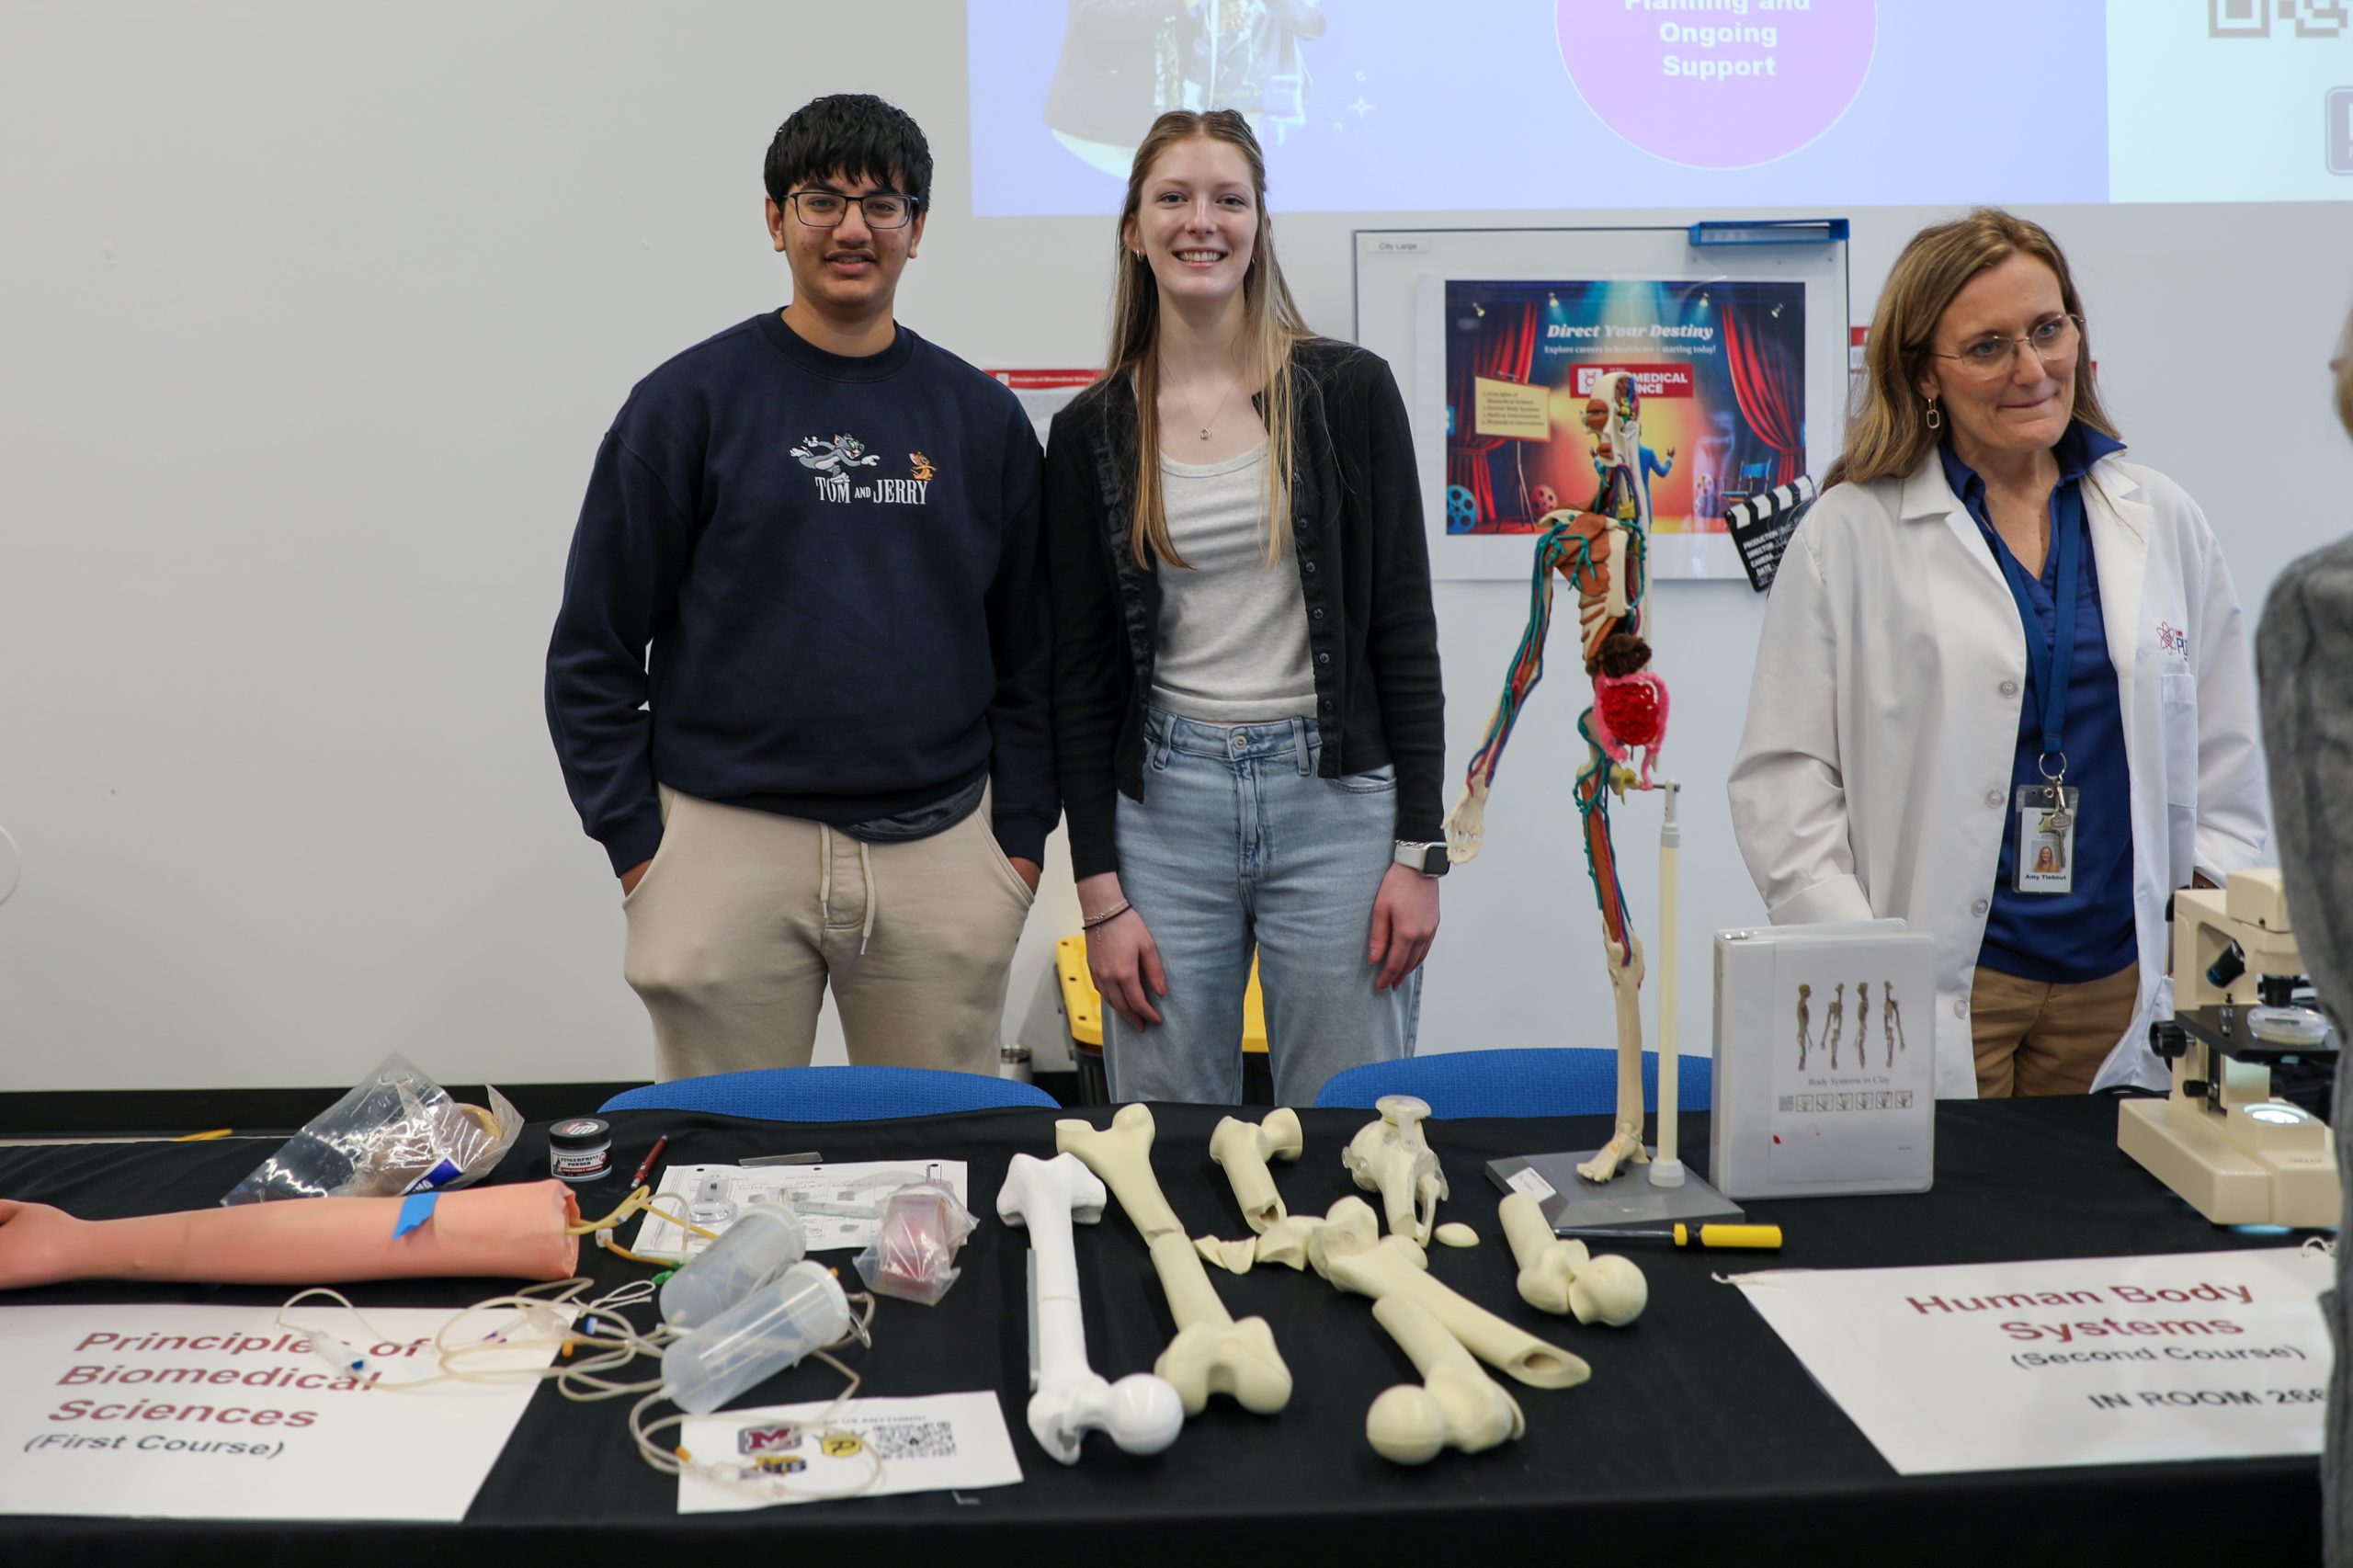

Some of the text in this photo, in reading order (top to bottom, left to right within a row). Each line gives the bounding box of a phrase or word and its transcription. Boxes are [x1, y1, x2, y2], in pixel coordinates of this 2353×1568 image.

[1659, 21, 1779, 48] Ongoing
[1662, 55, 1777, 81] Support
[1547, 324, 1714, 341] Direct Your Destiny
[1544, 345, 1716, 356] Explore careers in healthcare starting today!
[1633, 372, 1688, 383] MEDICAL
[814, 476, 928, 505] TOM AND JERRY
[1743, 530, 1779, 550] PRODUCTION
[1746, 541, 1775, 560] DIRECTOR
[1750, 552, 1775, 568] CAMERA
[1756, 564, 1773, 576] DATE
[2025, 873, 2040, 881] Amy
[1808, 1078, 1828, 1086] Body
[1830, 1077, 1861, 1086] Systems
[1872, 1075, 1890, 1085] Clay
[1906, 1282, 2255, 1315] Human Body
[1999, 1316, 2245, 1343] Systems
[74, 1332, 433, 1358] Principle of
[2010, 1342, 2308, 1369] (Second Course)
[56, 1365, 382, 1392] Biomedical
[2087, 1392, 2129, 1410] IN
[2136, 1391, 2263, 1409] ROOM
[48, 1399, 322, 1427] Sciences
[22, 1433, 286, 1460] (First Course)
